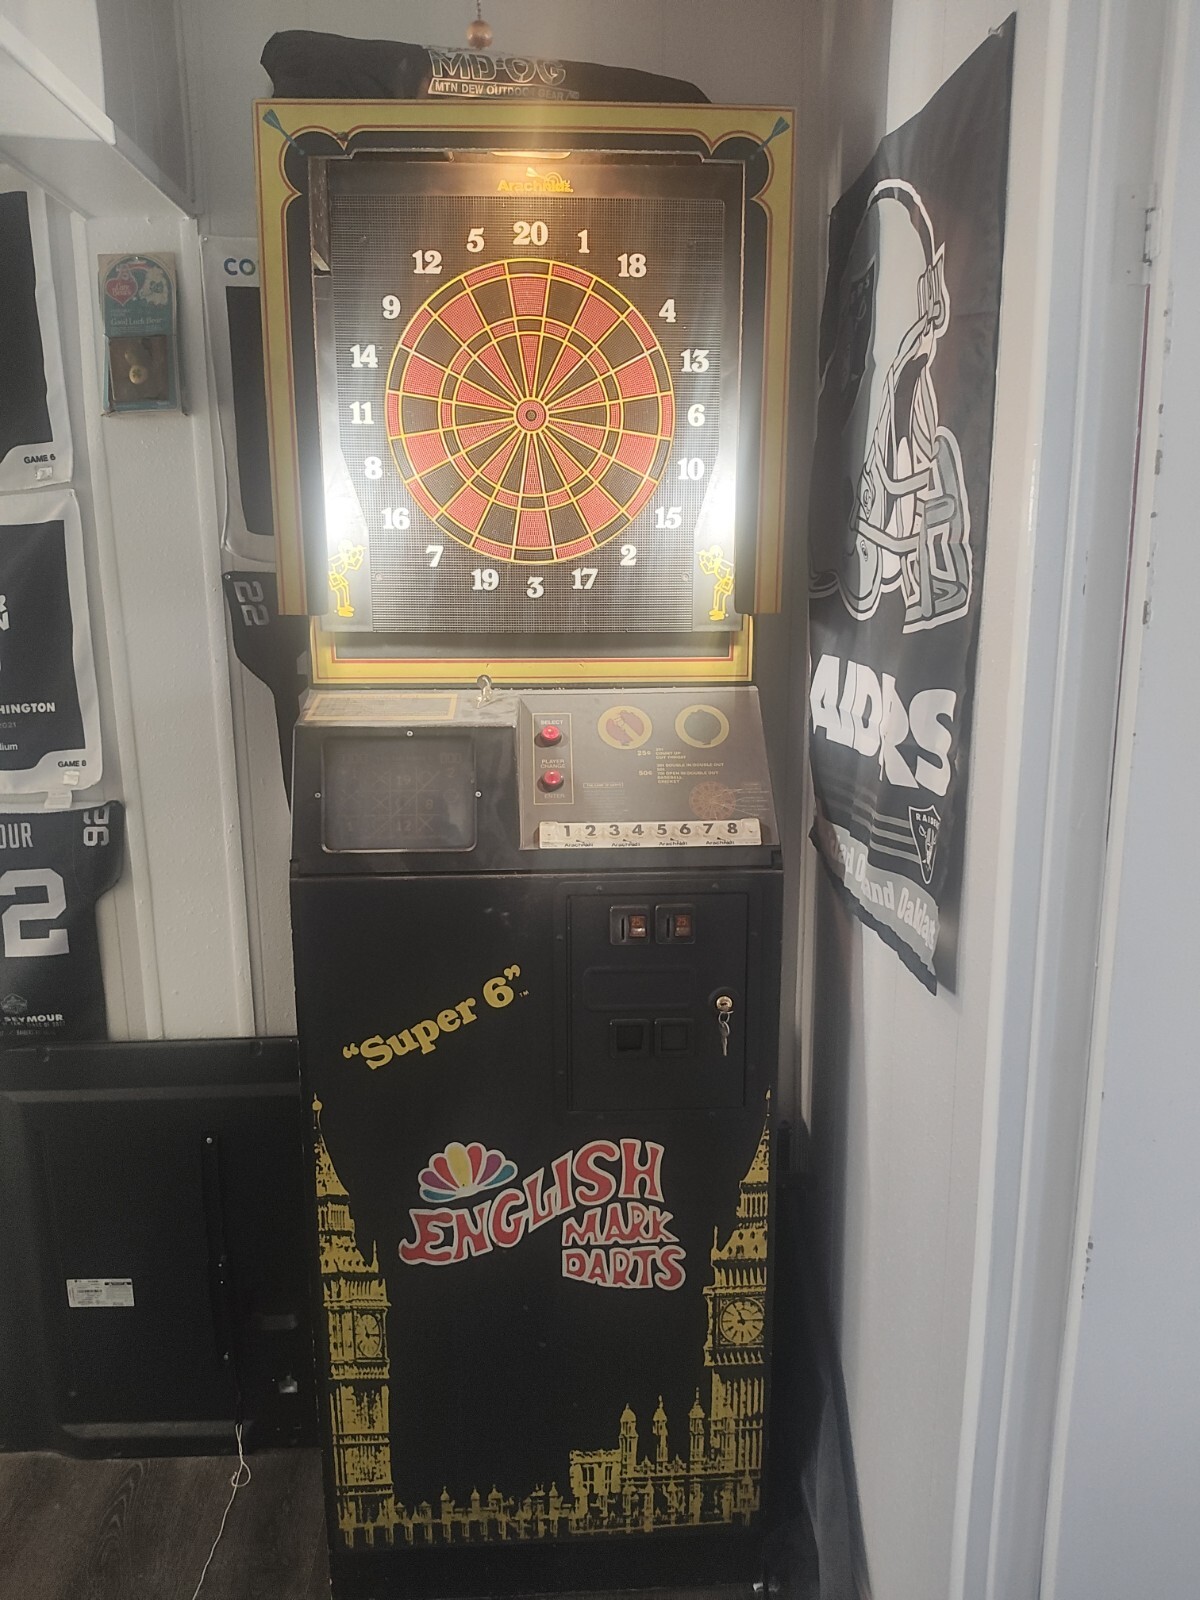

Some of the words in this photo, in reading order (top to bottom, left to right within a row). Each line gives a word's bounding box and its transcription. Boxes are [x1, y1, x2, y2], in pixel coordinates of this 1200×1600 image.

[435, 82, 458, 92] MTN
[461, 83, 484, 94] DEW
[466, 227, 485, 253] 5
[512, 221, 549, 246] 20
[577, 229, 590, 254] 1
[412, 249, 443, 275] 12
[617, 253, 647, 278] 18
[382, 295, 401, 319] 9
[658, 298, 677, 323] 4
[350, 344, 379, 368] 14
[680, 348, 710, 373] 13
[350, 401, 375, 425] 11
[687, 403, 706, 427] 6
[24, 454, 48, 464] GAME
[50, 453, 56, 461] 6
[364, 456, 383, 480] 8
[677, 457, 706, 480] 10
[381, 506, 410, 530] 16
[654, 506, 682, 529] 15
[425, 545, 444, 568] 7
[620, 544, 638, 567] 2
[470, 568, 500, 592] 19
[526, 576, 545, 599] 3
[571, 567, 599, 590] 17
[564, 825, 571, 837] 1
[585, 825, 597, 836] 2
[609, 824, 621, 836] 3
[632, 824, 645, 836] 4
[657, 824, 668, 836] 5
[680, 823, 692, 835] 6
[703, 823, 714, 834] 7
[727, 822, 738, 834] 8
[915, 812, 940, 830] RAIDE
[0, 868, 70, 958] 2
[399, 1138, 665, 1266] ENGLISH
[562, 1202, 680, 1247] MARK
[562, 1245, 687, 1291] DARTS
